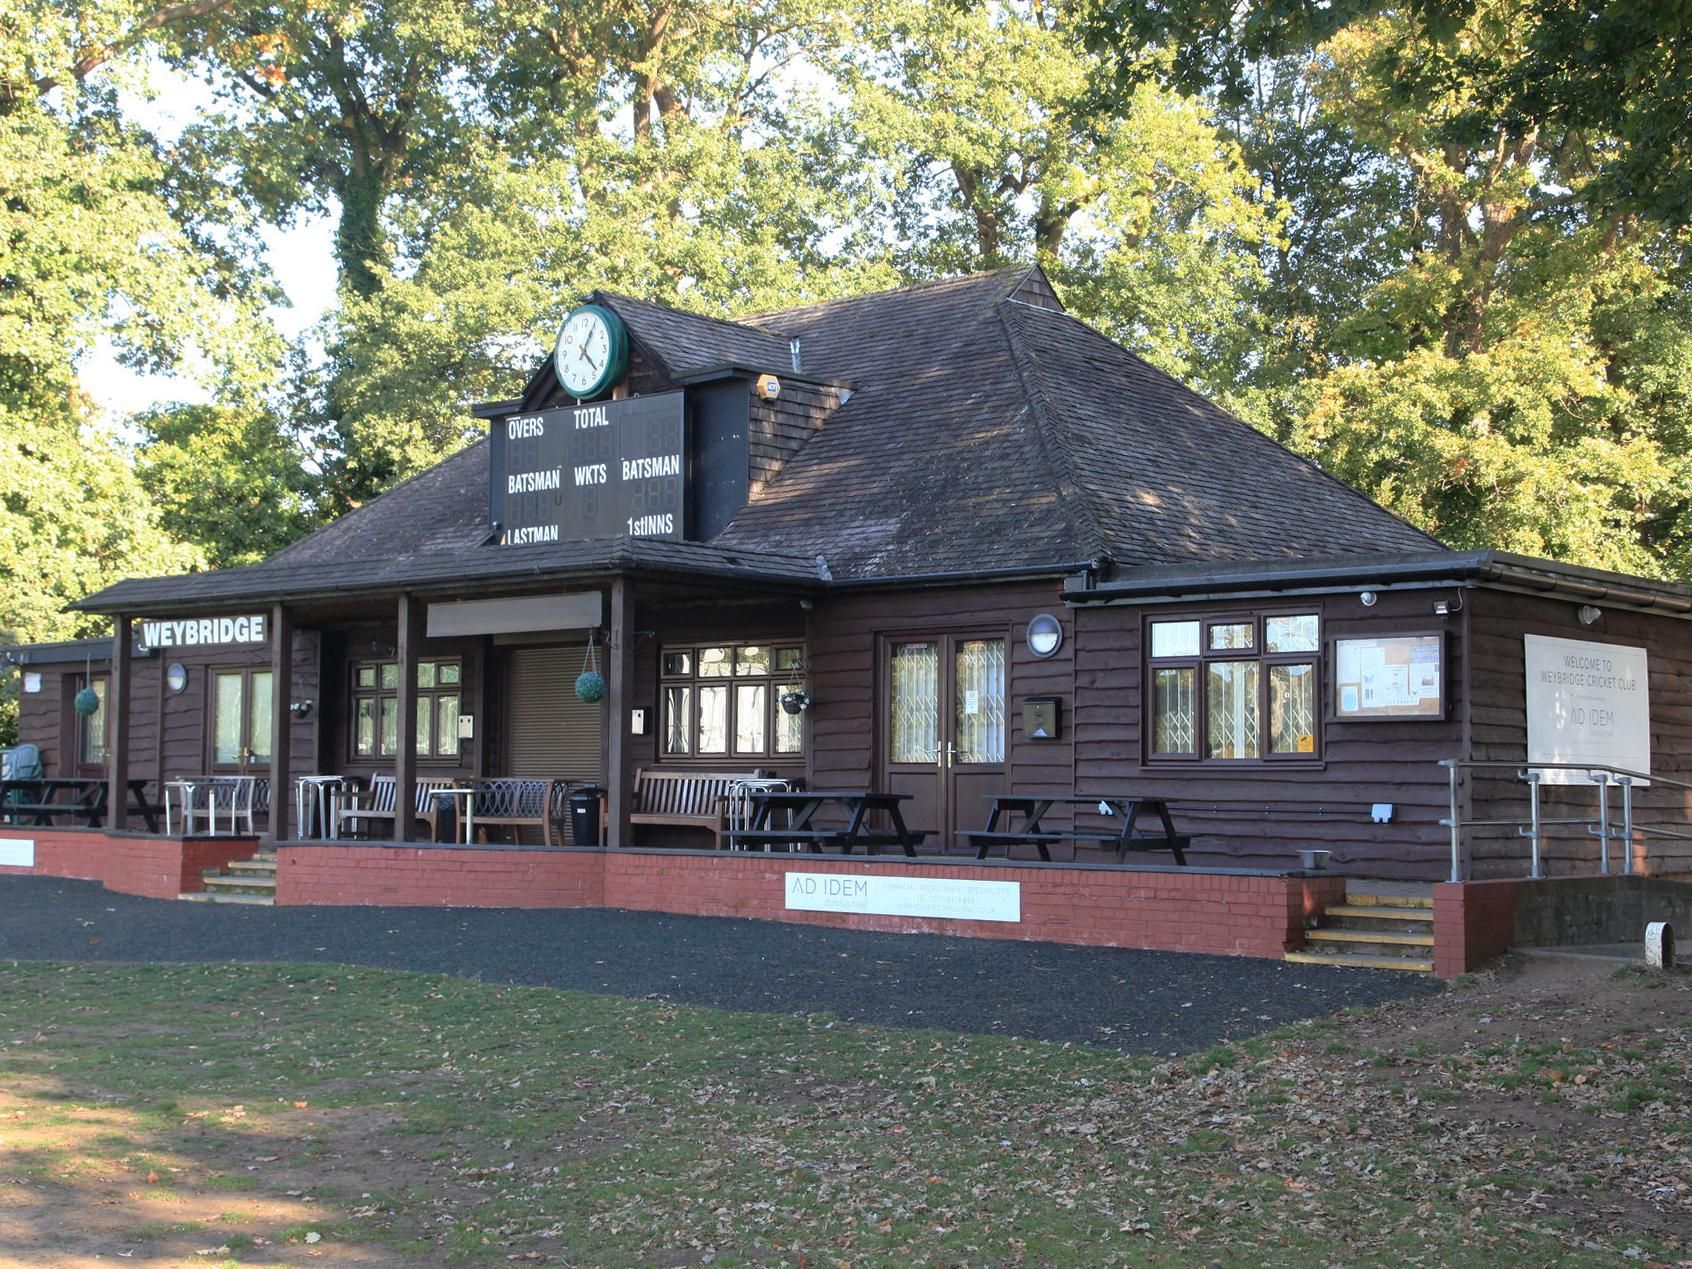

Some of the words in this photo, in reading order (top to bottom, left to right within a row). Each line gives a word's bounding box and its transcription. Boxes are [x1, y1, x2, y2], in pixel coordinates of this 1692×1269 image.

[581, 318, 588, 329] 12
[564, 335, 573, 344] 10
[509, 417, 544, 440] OVERS
[574, 406, 609, 430] TOTAL
[508, 470, 560, 494] BATSMAN
[574, 464, 607, 486] WKTS
[622, 455, 680, 481] BATSMAN
[144, 616, 264, 647] WEYBRIDGE
[1564, 655, 1601, 671] WELCOME
[1602, 659, 1612, 673] TO
[1540, 671, 1585, 687] WEYBRIDGE
[1586, 675, 1618, 690] CRICKET
[1619, 679, 1636, 691] CLUB
[1571, 708, 1585, 725] AD
[1589, 709, 1614, 727] IDEM
[792, 877, 817, 895] AD
[824, 879, 868, 897] IDEM
